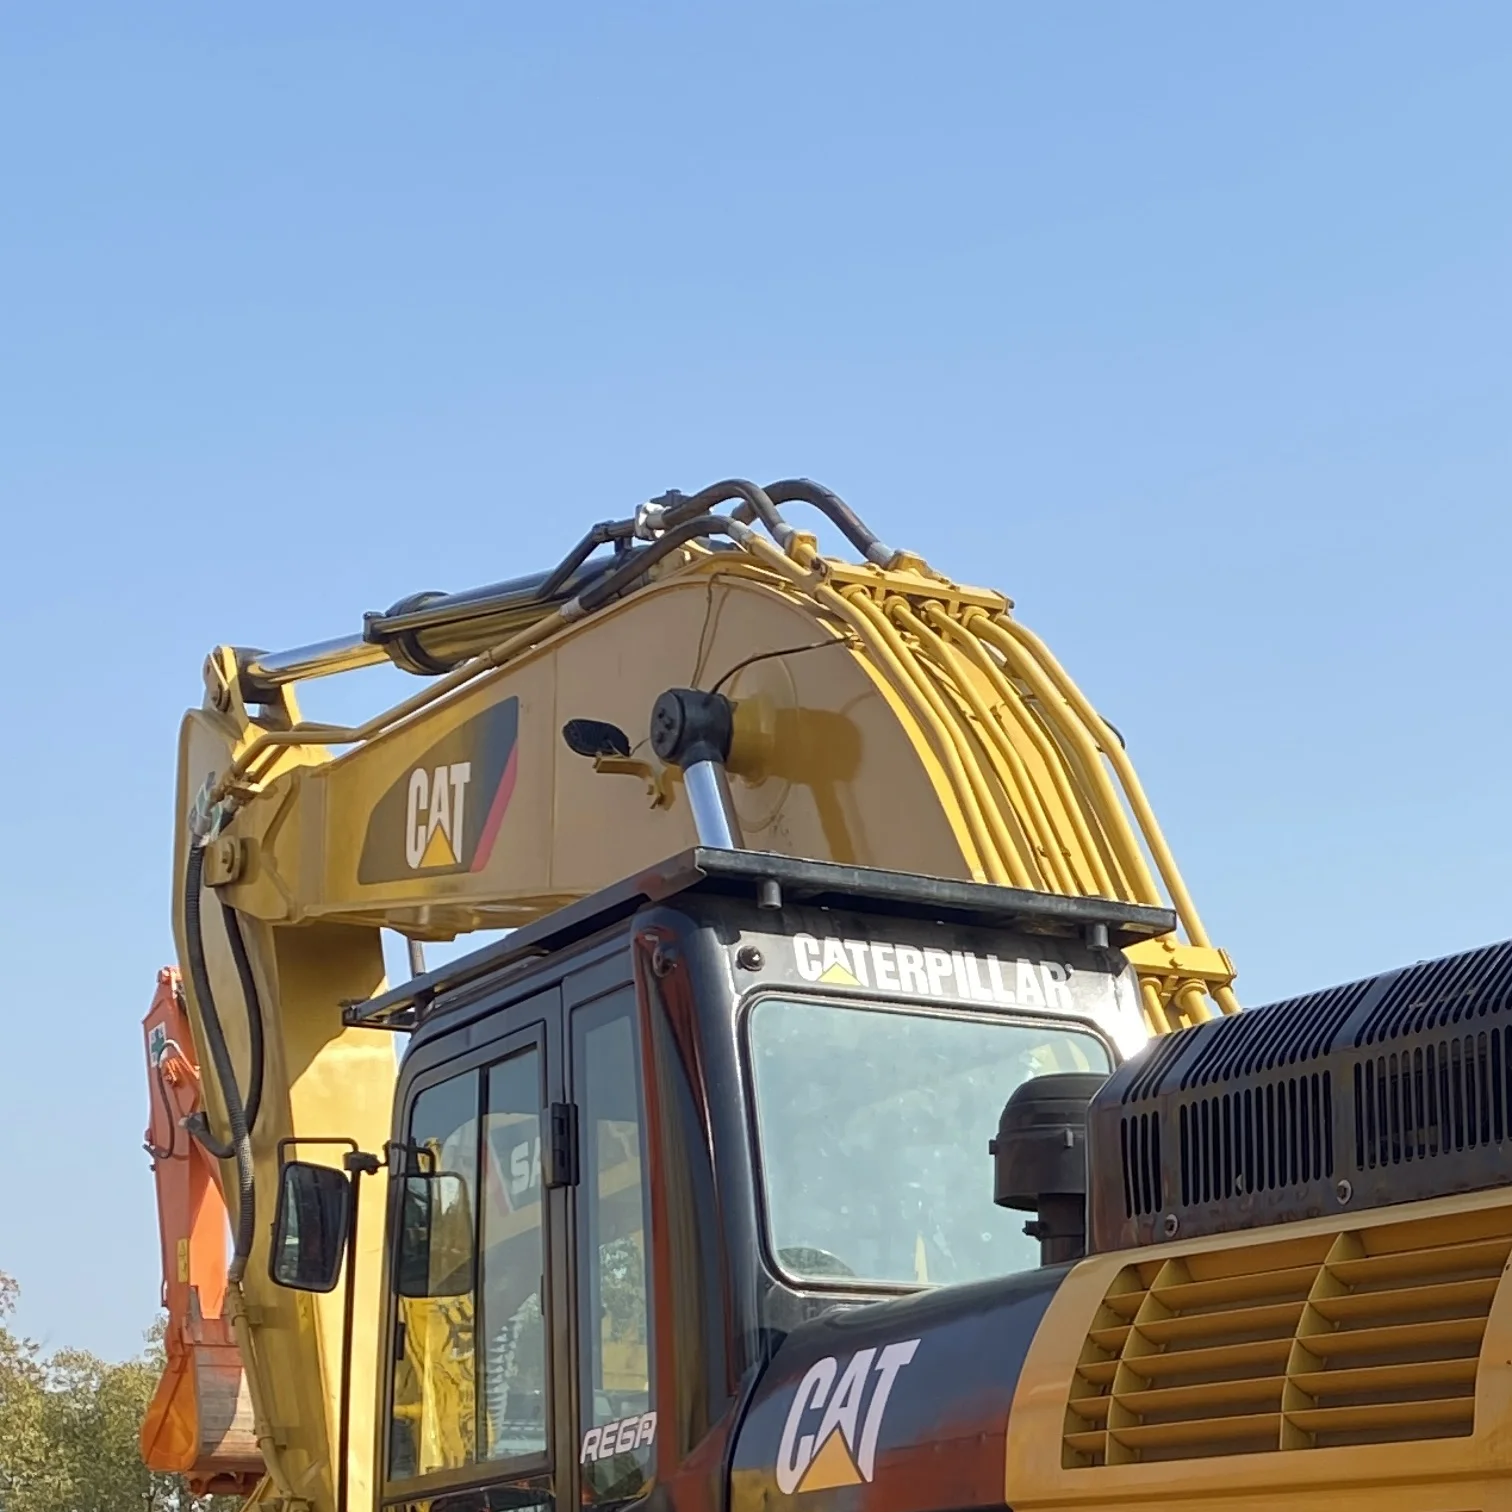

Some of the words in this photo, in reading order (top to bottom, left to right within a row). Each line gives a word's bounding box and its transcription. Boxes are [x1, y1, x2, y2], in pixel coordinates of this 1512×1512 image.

[405, 762, 470, 868] CAT
[793, 932, 1072, 1009] CATERPILLAR
[580, 1411, 657, 1464] REGA
[776, 1339, 921, 1494] CAT
